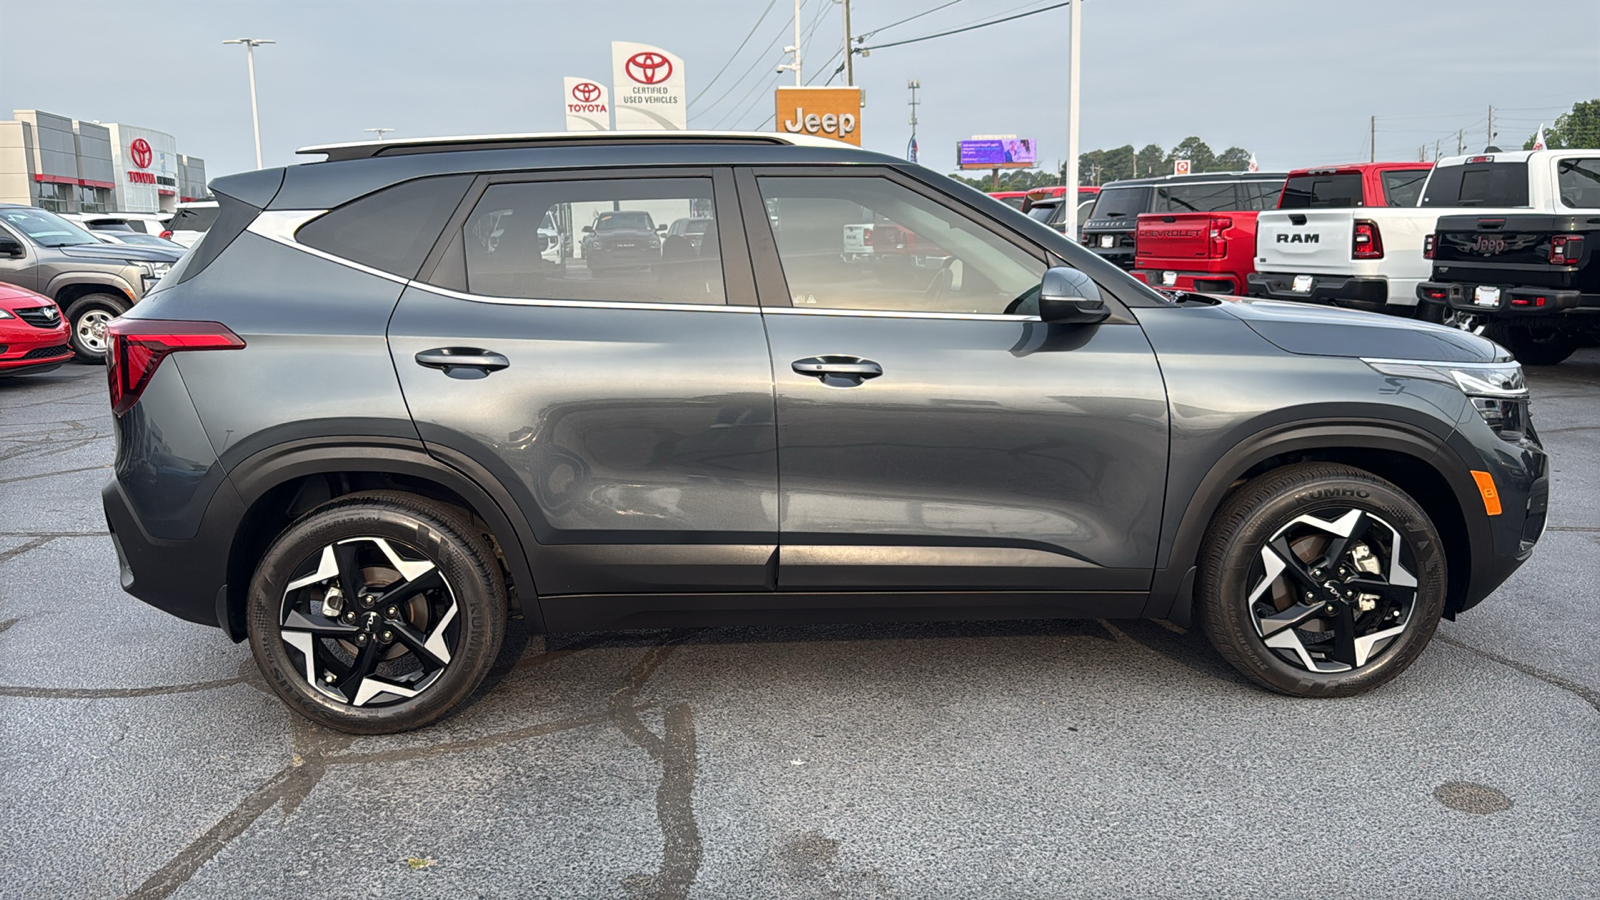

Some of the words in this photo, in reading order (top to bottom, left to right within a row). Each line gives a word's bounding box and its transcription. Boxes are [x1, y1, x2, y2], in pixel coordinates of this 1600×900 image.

[632, 86, 668, 95] CERTIFIED
[623, 95, 643, 104] USED
[645, 95, 678, 104] VEHICLES
[567, 104, 607, 113] TOYOTA
[784, 107, 856, 138] Jeep
[128, 171, 157, 184] TOYOTA
[1139, 229, 1202, 238] CHEVROLET
[1276, 233, 1320, 244] RAM
[1473, 235, 1505, 255] Jeep
[1293, 486, 1371, 504] KUMHO
[462, 601, 482, 672] KUMHO
[270, 667, 334, 719] SOLUS
